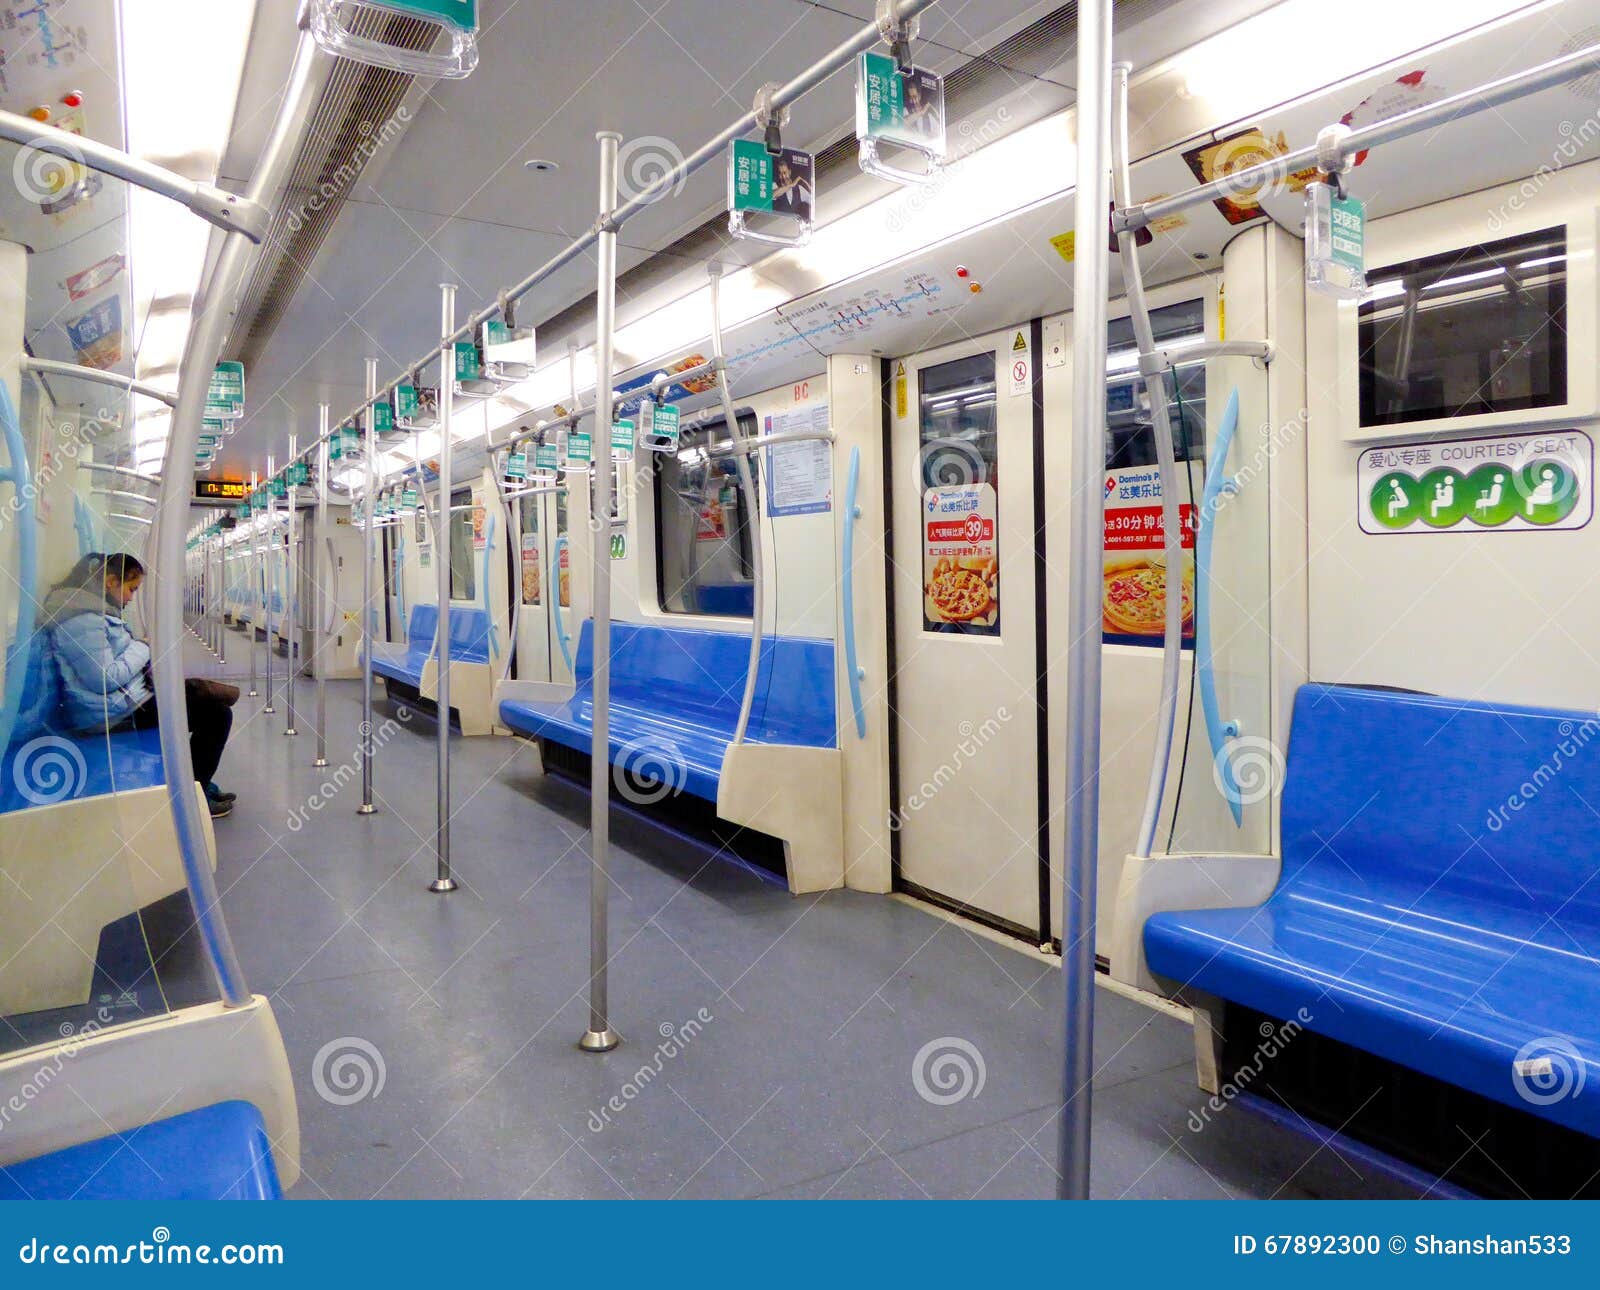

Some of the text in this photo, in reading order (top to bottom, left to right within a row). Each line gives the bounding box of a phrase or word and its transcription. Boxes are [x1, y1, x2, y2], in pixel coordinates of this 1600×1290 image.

[870, 74, 881, 121] 安居客
[738, 156, 750, 195] 安居客
[1332, 207, 1361, 232] 安居客
[794, 382, 809, 402] BC
[1368, 437, 1578, 469] 爱心专座 COURTESY SEAT
[1119, 472, 1152, 484] Domino's
[1120, 484, 1162, 499] 达美乐比
[966, 520, 981, 538] 39
